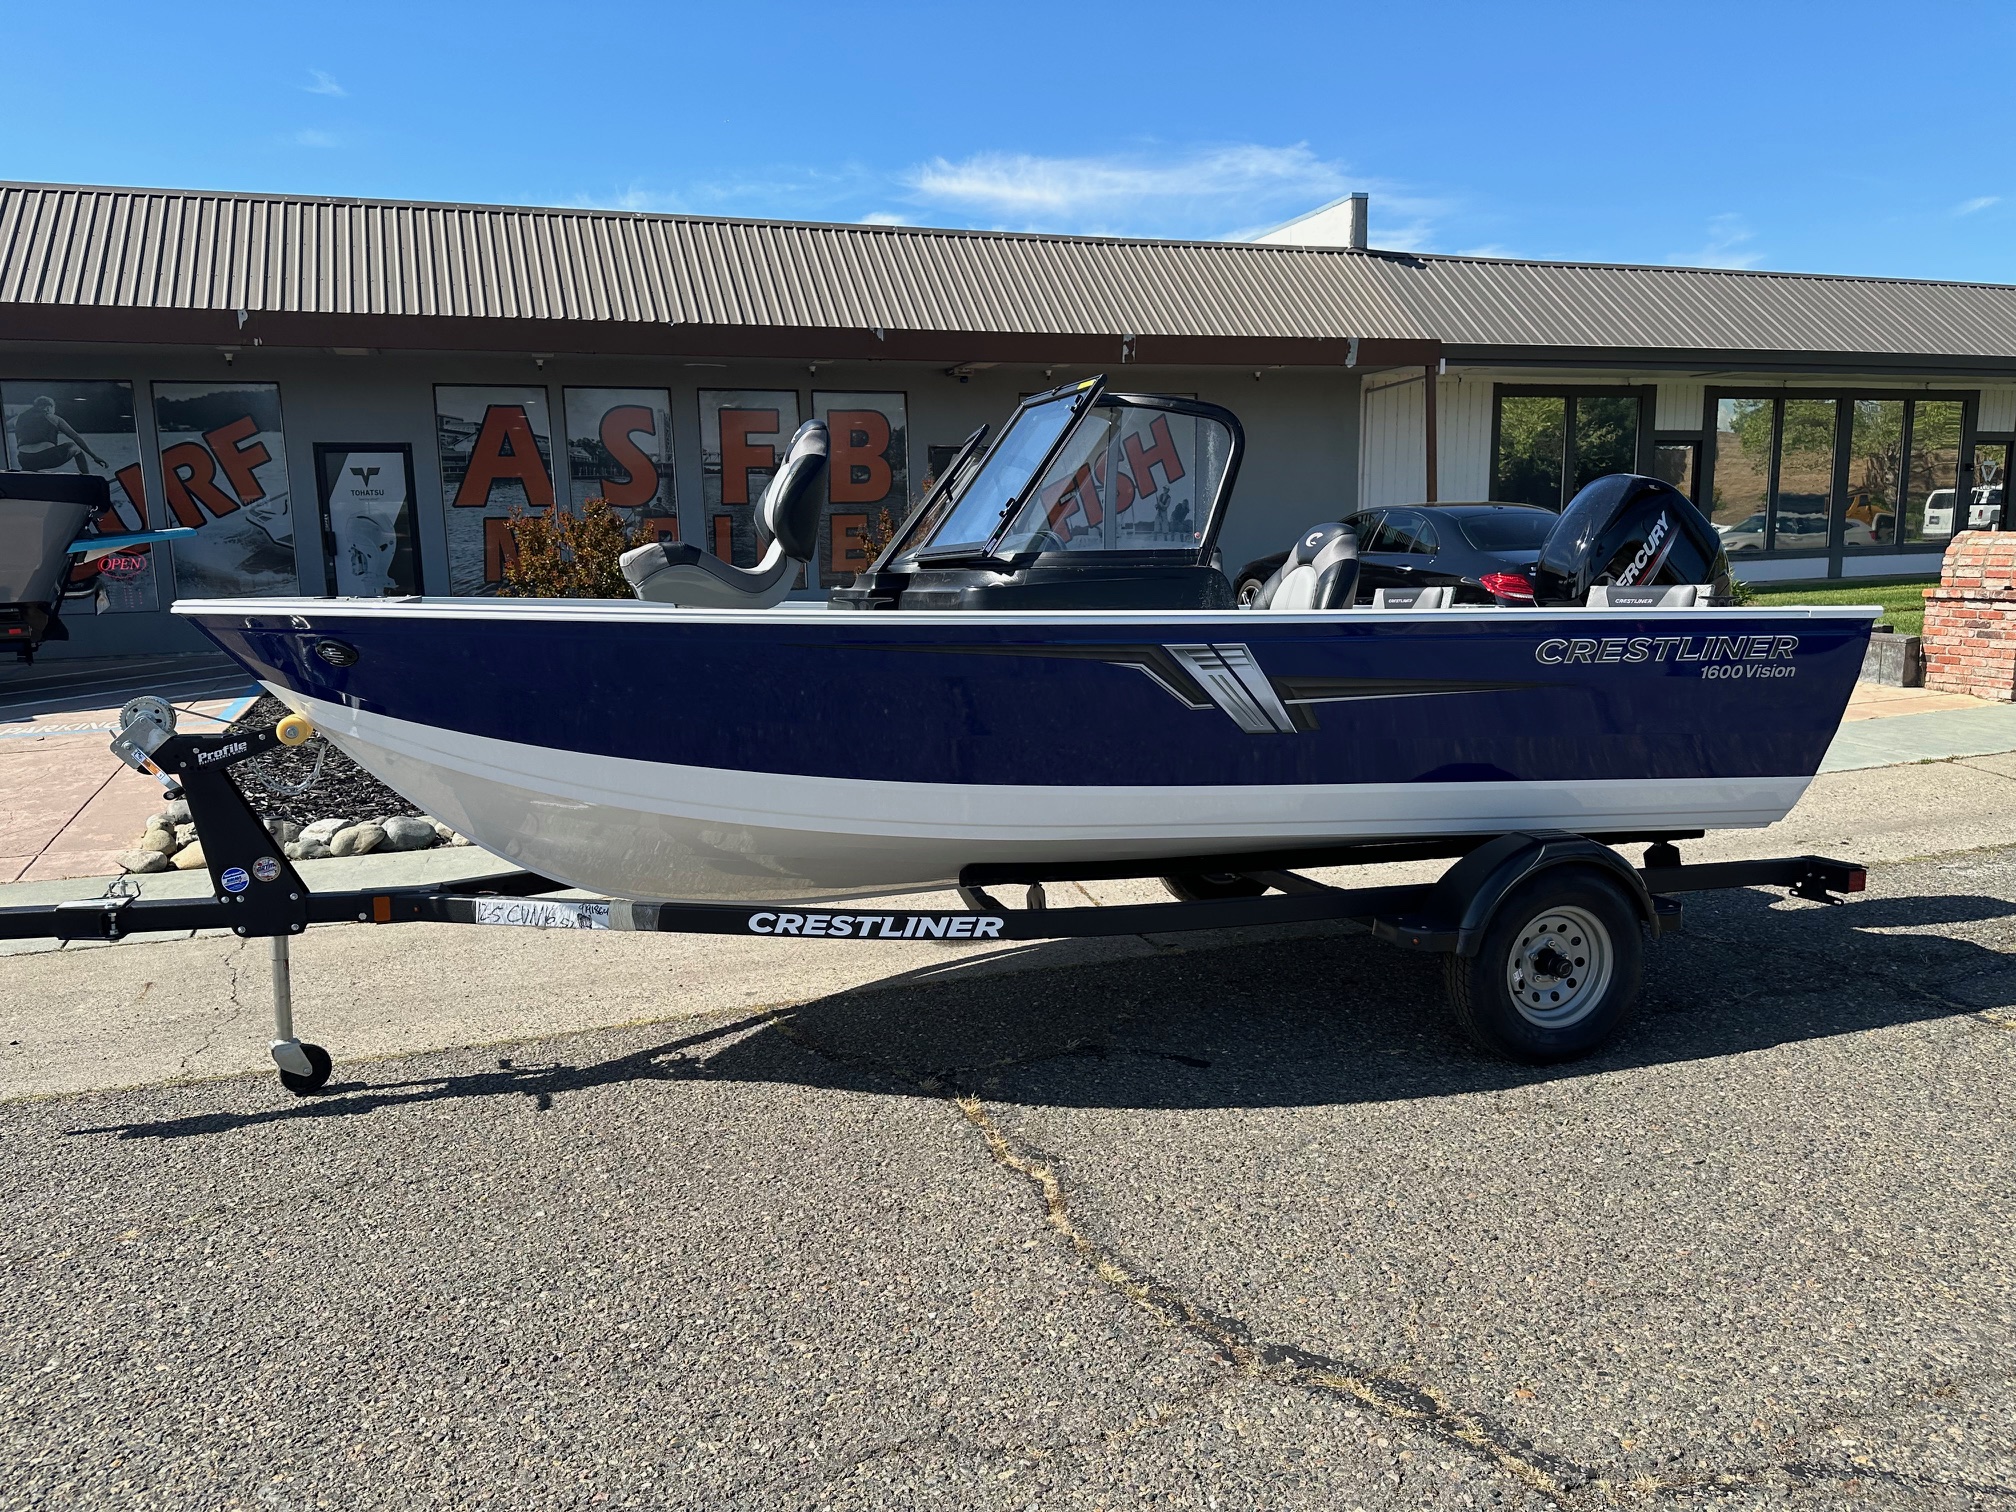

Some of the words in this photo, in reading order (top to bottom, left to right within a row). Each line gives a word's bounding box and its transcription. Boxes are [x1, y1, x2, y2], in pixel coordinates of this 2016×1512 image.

[350, 489, 385, 497] TOHATSU
[1615, 510, 1668, 587] ERCURY
[100, 558, 141, 571] OPEN
[1535, 635, 1799, 665] CRESTLINER
[1700, 665, 1743, 679] 1600
[1745, 664, 1796, 678] Vision
[197, 741, 247, 763] Profile
[748, 912, 1004, 938] CRESTLINER
